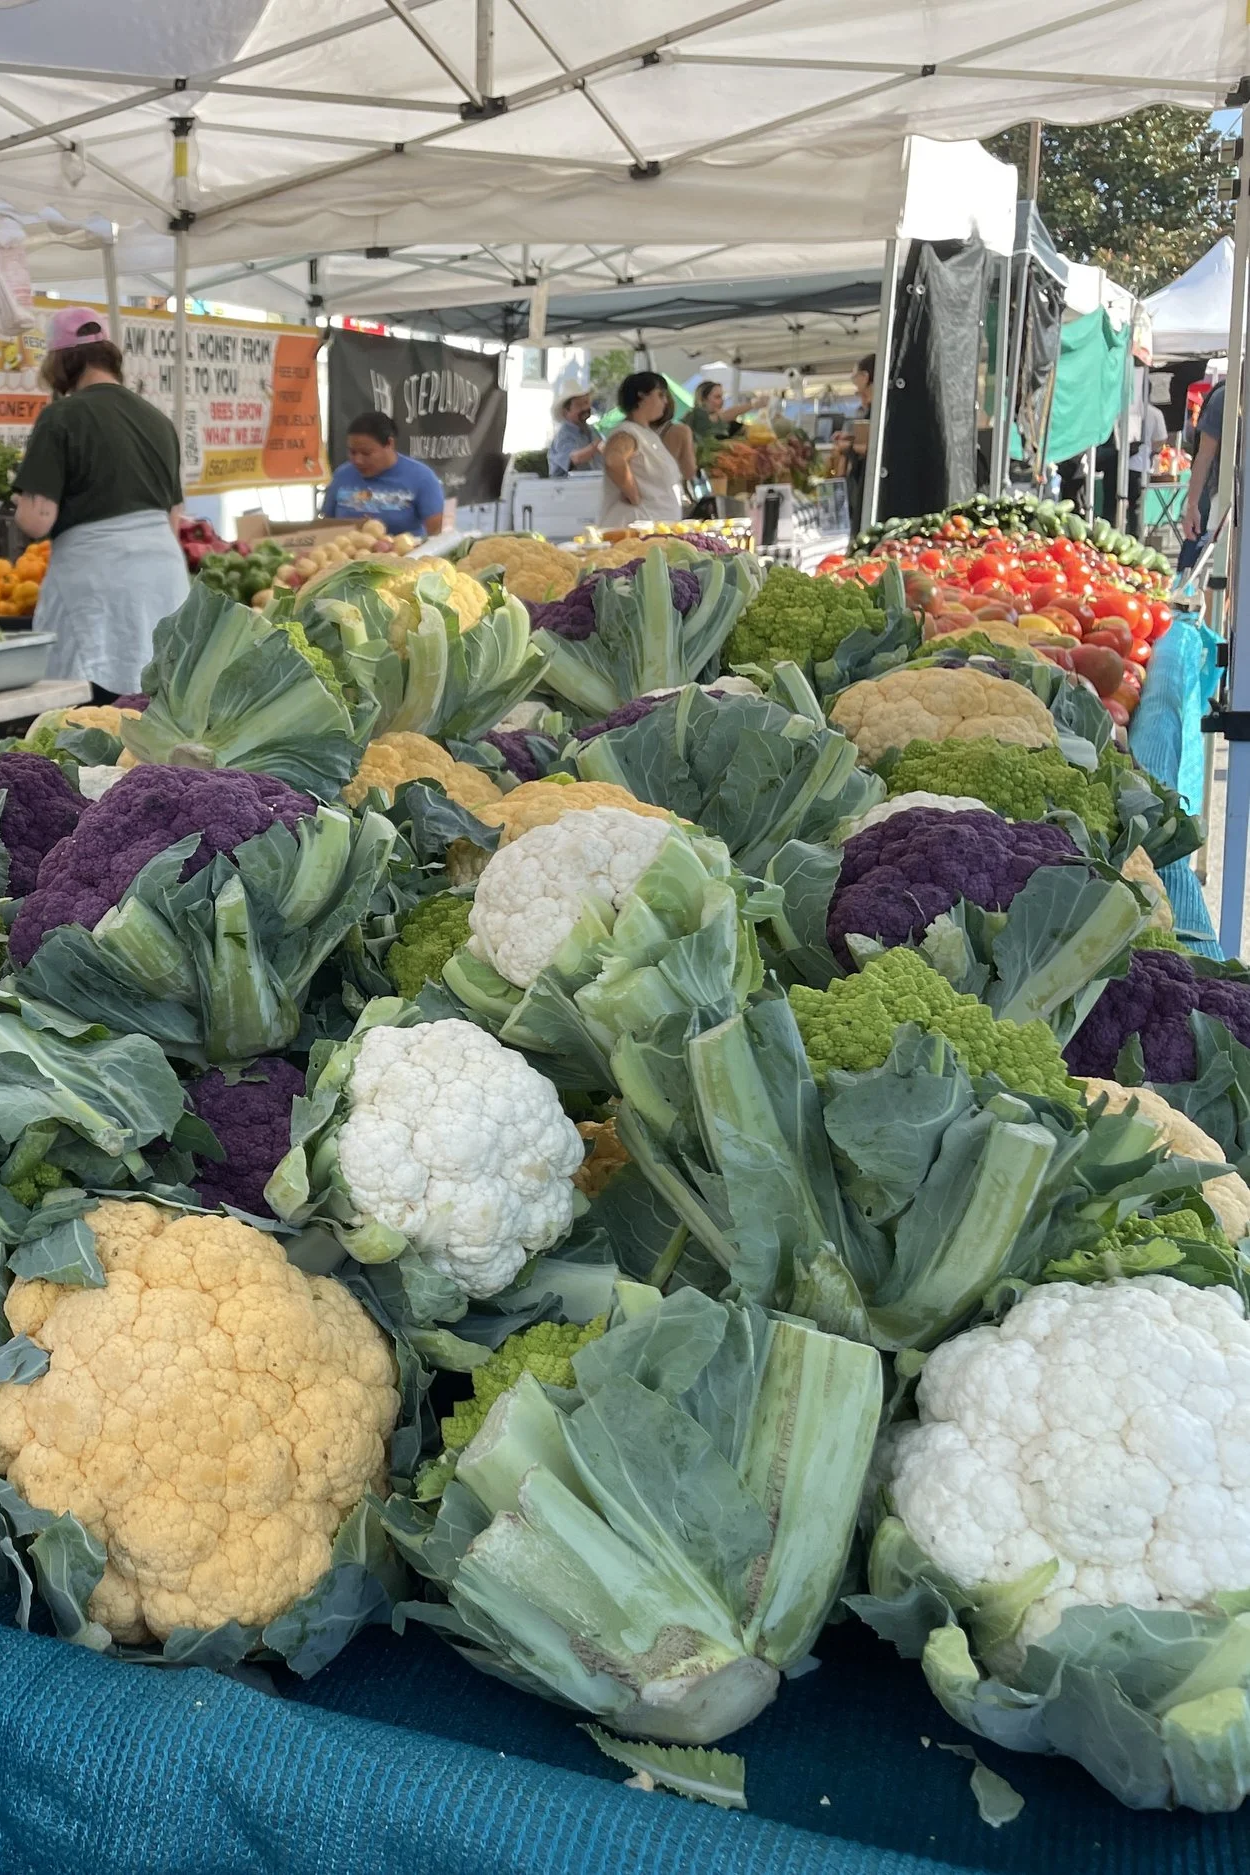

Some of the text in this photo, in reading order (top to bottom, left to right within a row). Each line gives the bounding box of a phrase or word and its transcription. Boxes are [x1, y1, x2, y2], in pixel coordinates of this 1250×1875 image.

[124, 326, 271, 364] AW LOCL HONEY FROM
[159, 364, 238, 394] HIE TO YOU
